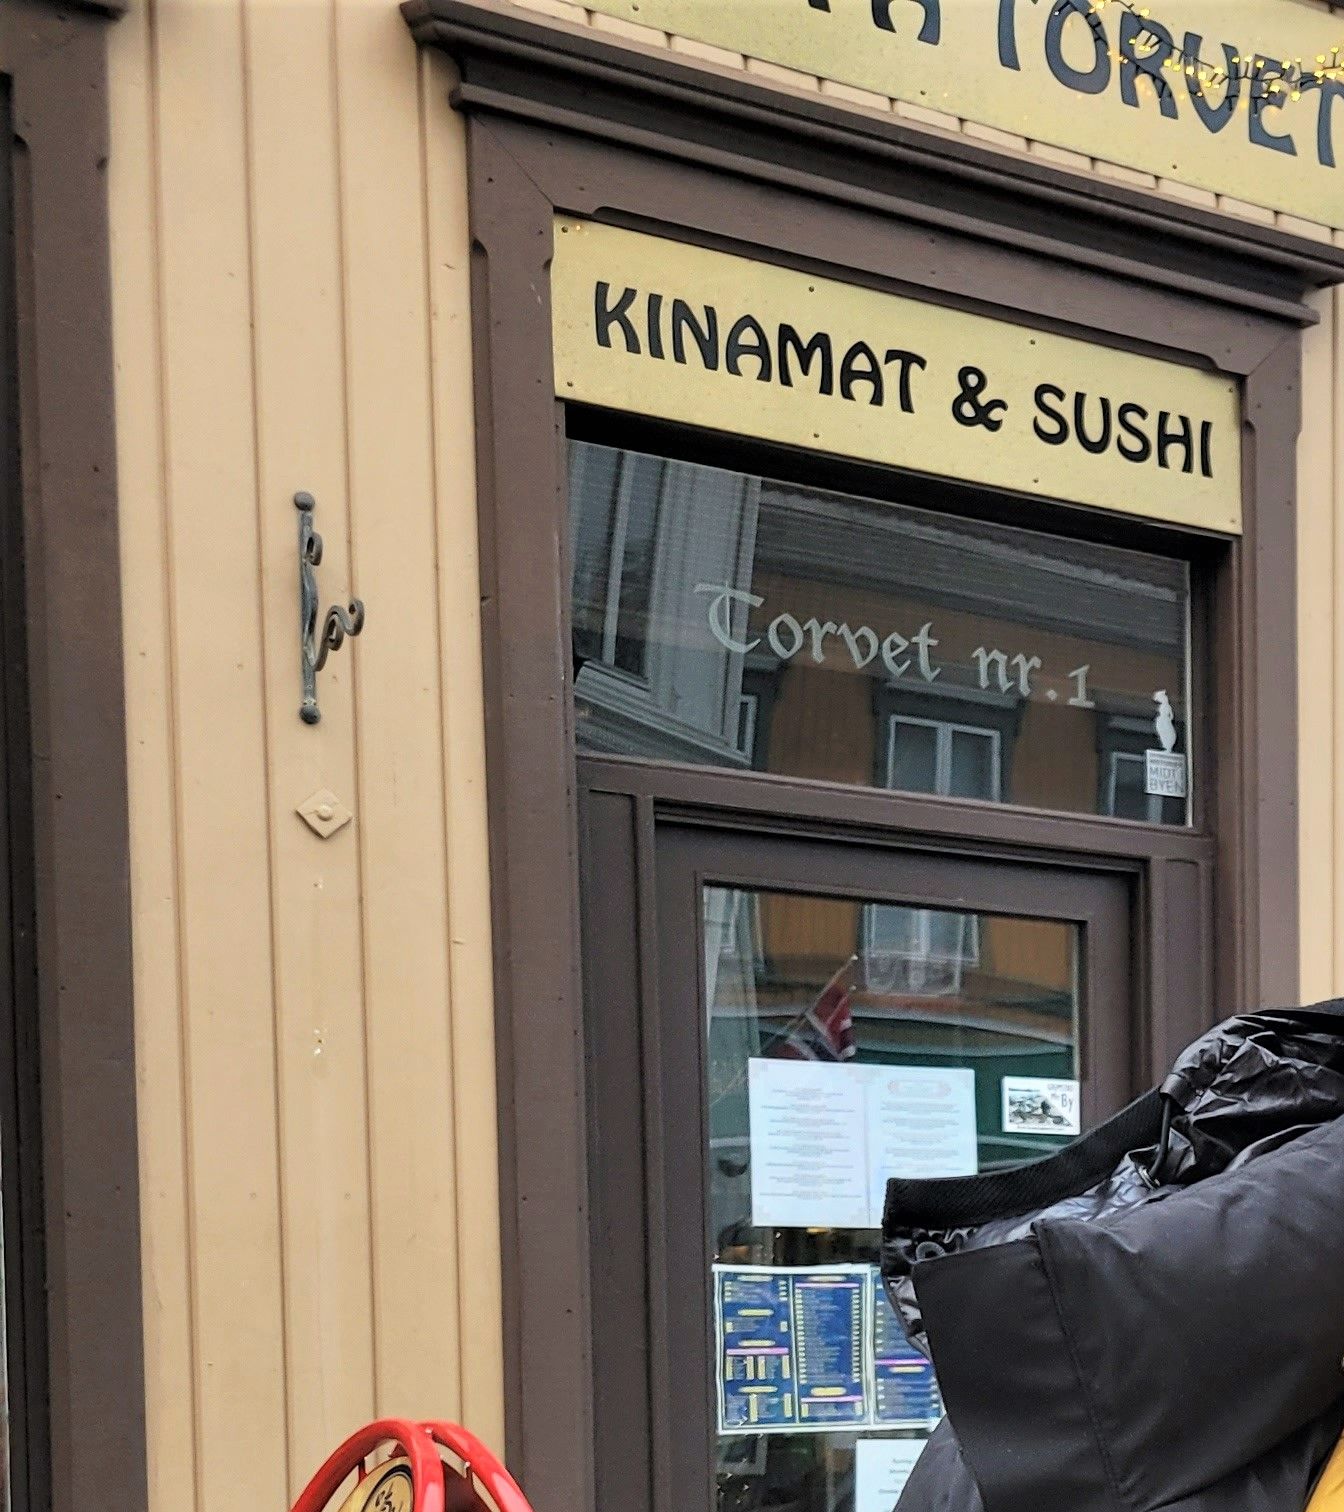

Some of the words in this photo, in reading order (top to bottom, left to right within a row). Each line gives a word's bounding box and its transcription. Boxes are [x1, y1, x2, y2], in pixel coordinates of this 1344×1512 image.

[593, 281, 927, 416] KINAMAT
[951, 366, 1007, 433] &
[1033, 382, 1215, 479] SUSHI
[693, 580, 942, 684] Torvet
